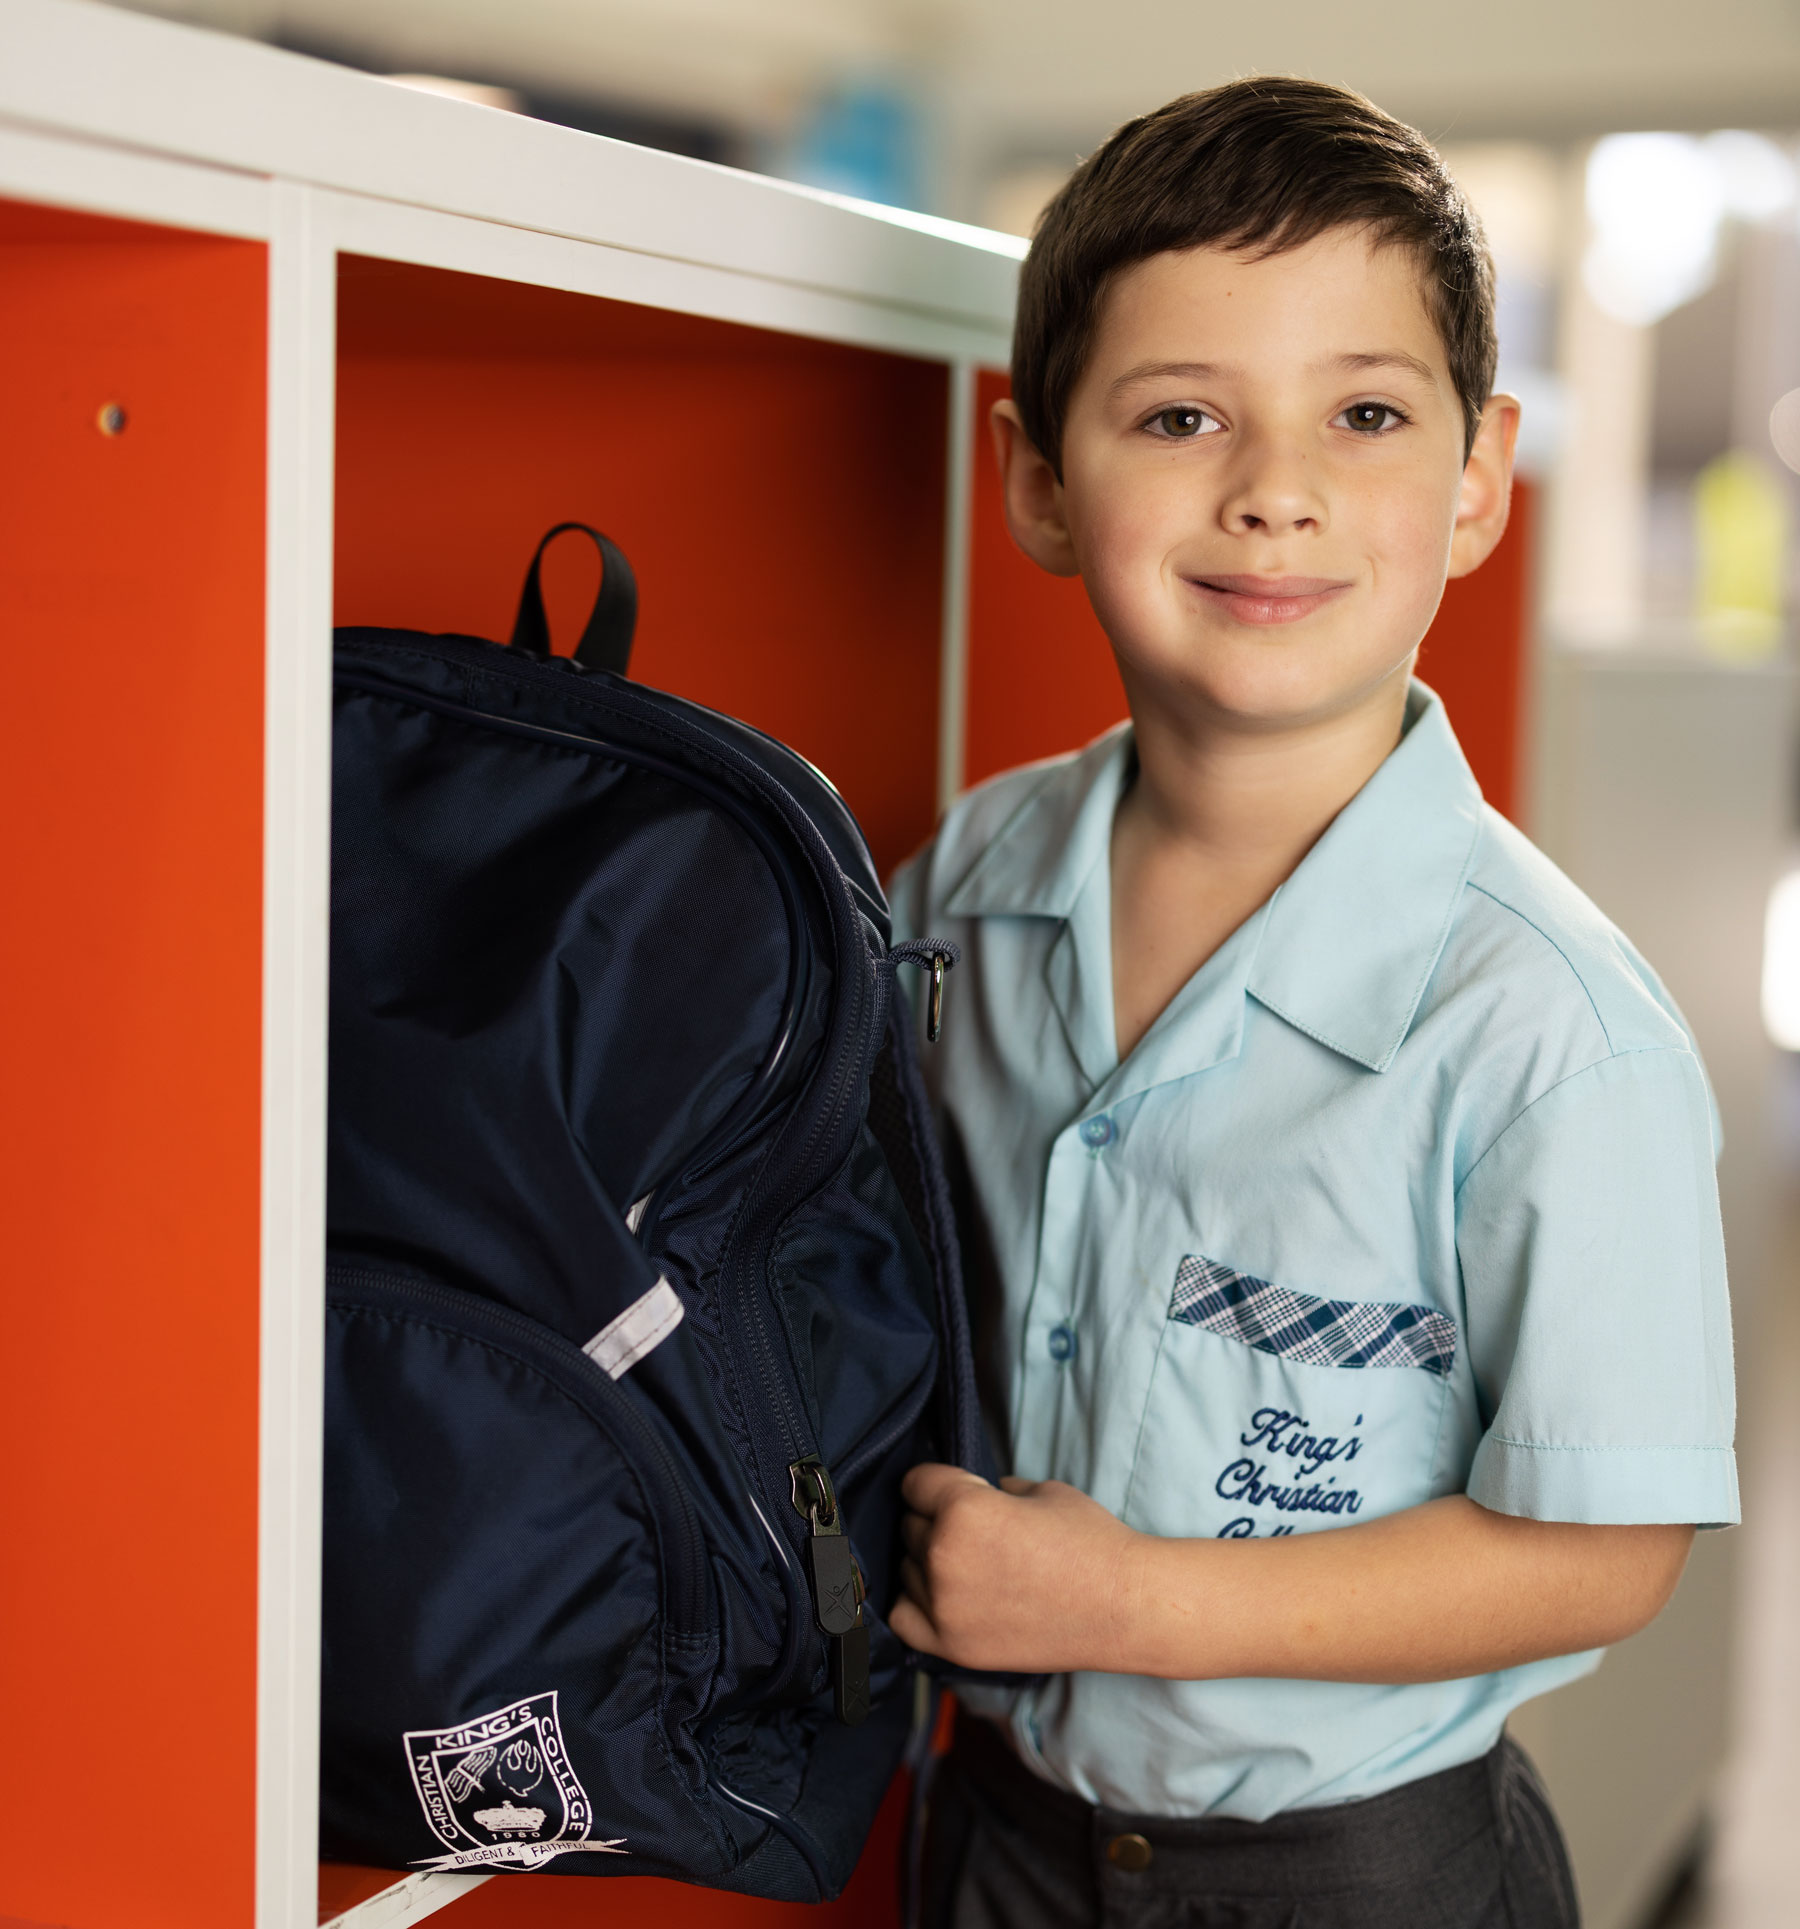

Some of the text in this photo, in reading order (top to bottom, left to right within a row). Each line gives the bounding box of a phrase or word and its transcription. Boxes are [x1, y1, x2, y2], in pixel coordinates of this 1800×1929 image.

[1240, 1407, 1363, 1475] King's
[1215, 1458, 1364, 1514] Christian
[435, 1705, 532, 1749] KING'S
[416, 1754, 459, 1839] CHRISTIAN
[540, 1716, 585, 1831] COLLEGE
[454, 1842, 591, 1865] DILIGENT & FAITHFUL
